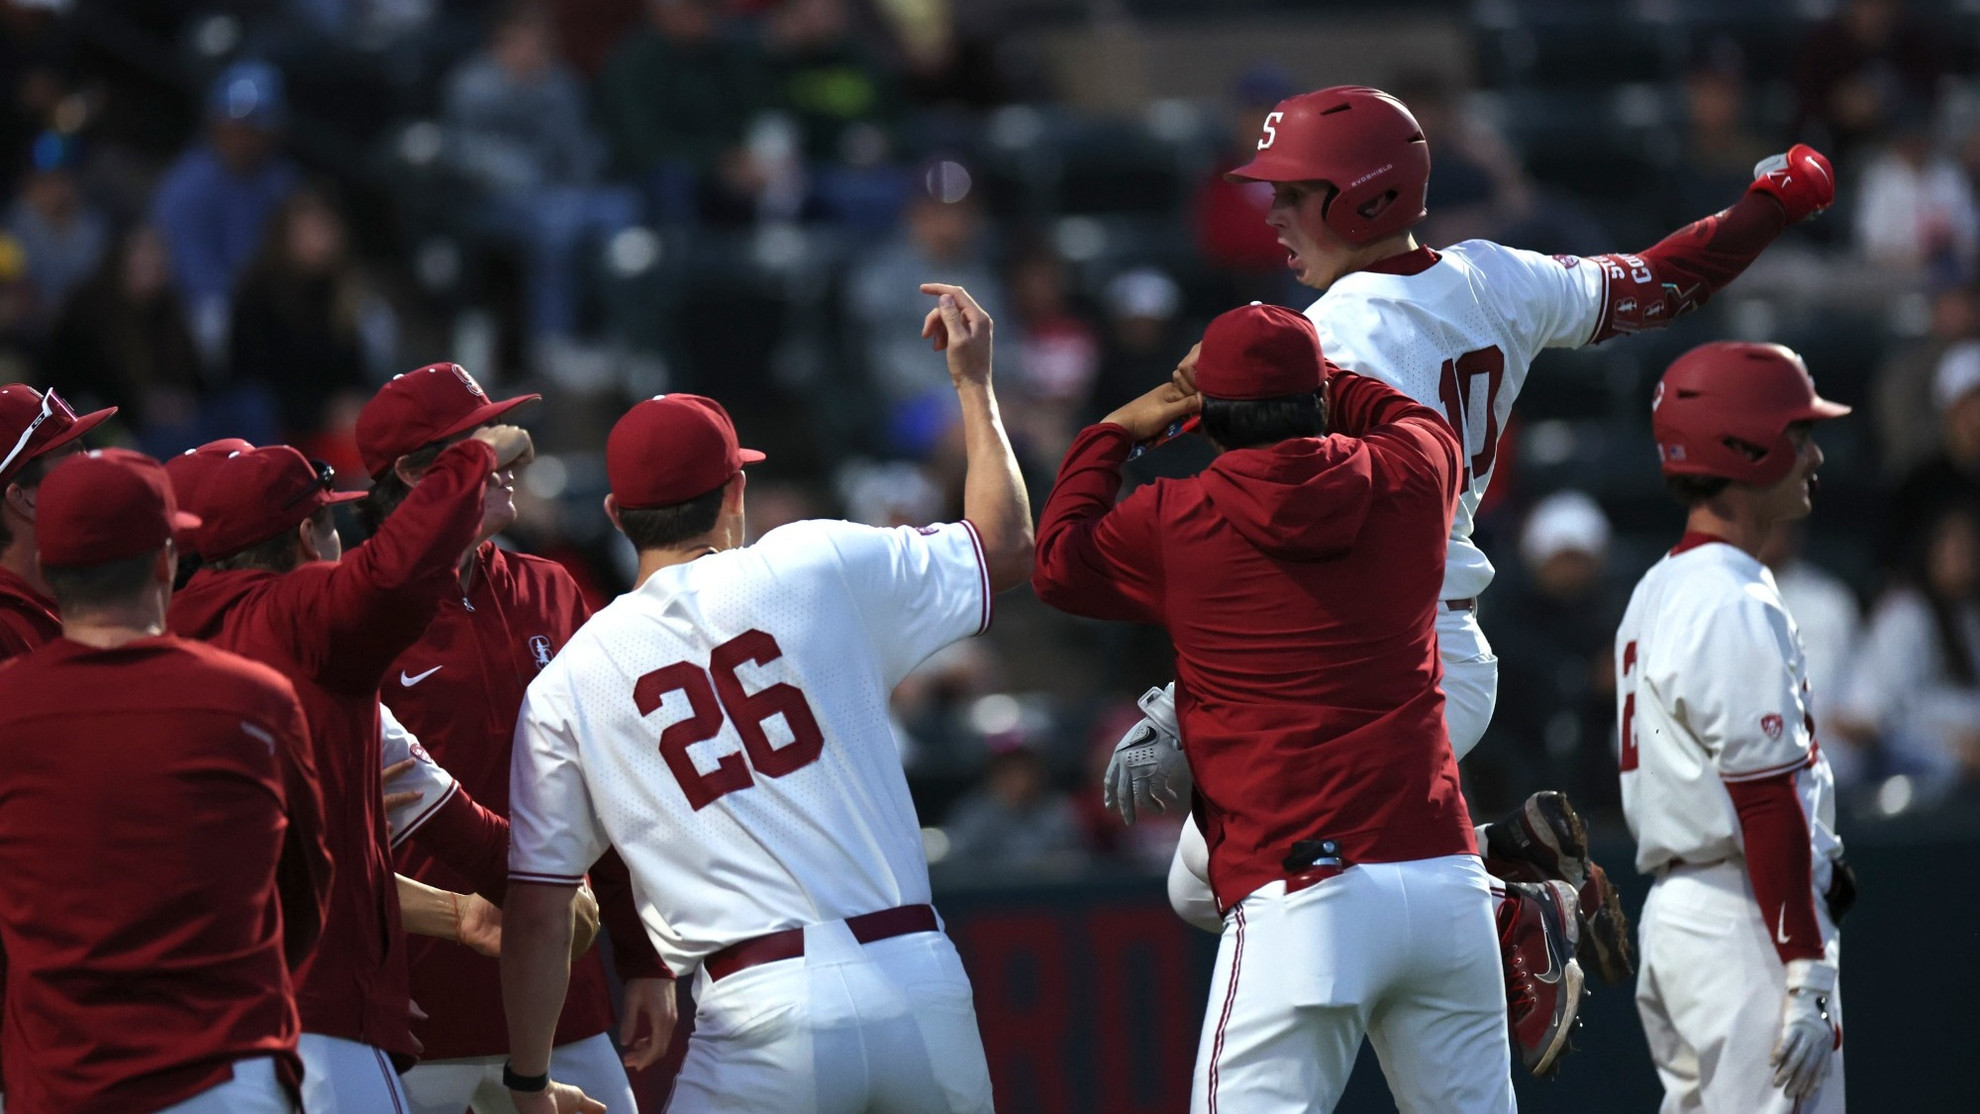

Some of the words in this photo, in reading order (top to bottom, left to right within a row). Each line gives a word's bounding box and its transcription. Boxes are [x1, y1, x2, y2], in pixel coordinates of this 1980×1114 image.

[1257, 112, 1283, 150] S
[1439, 344, 1504, 495] 10
[633, 628, 824, 812] 26
